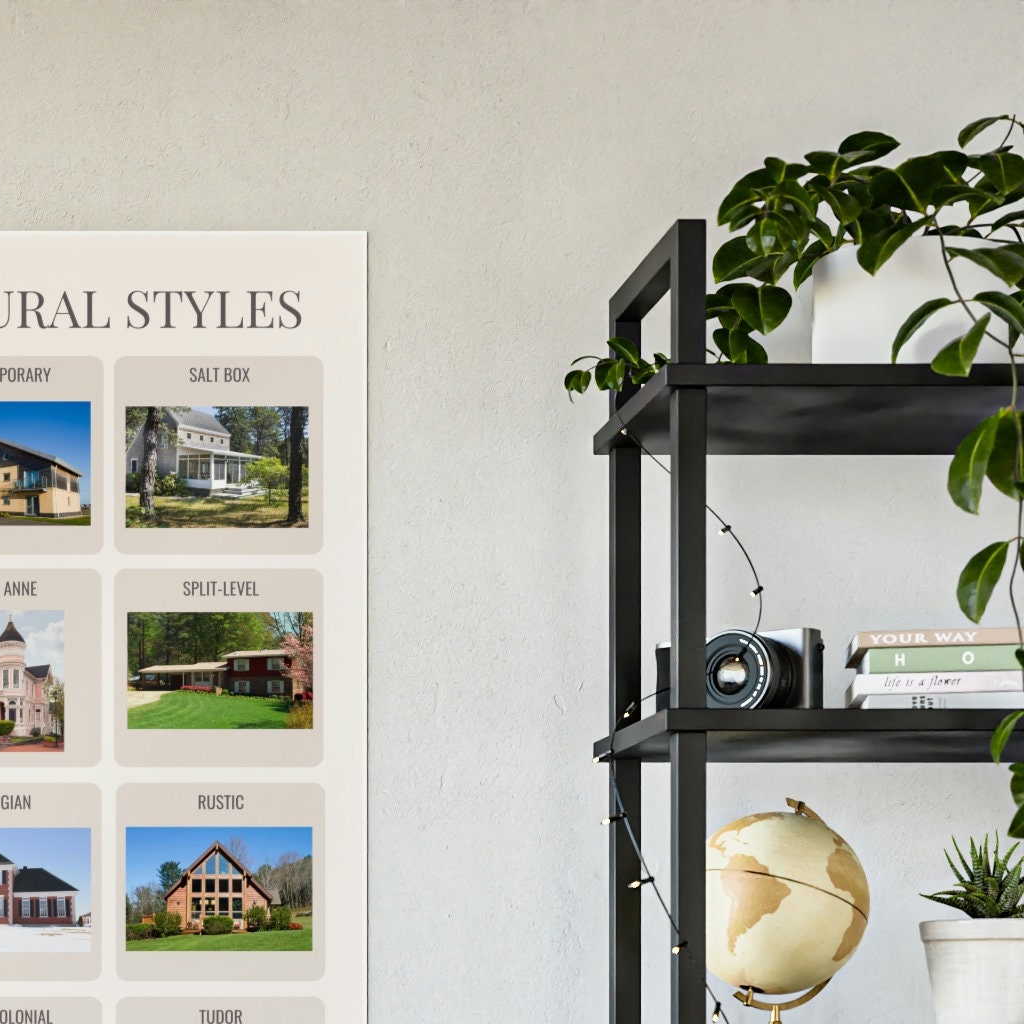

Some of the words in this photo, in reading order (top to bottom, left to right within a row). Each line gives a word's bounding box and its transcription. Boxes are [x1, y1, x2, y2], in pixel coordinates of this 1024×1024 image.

[126, 289, 302, 330] STYLES
[189, 367, 220, 383] SALT
[223, 367, 250, 383] BOX
[3, 580, 38, 597] ANNE
[182, 580, 260, 597] SPLIT-LEVEL
[870, 633, 928, 645] YOUR
[934, 631, 978, 643] WAY
[884, 674, 901, 688] life
[905, 679, 914, 687] is
[927, 674, 963, 689] flower
[197, 794, 245, 810] RUSTIC
[198, 1009, 243, 1024] TUDOR
